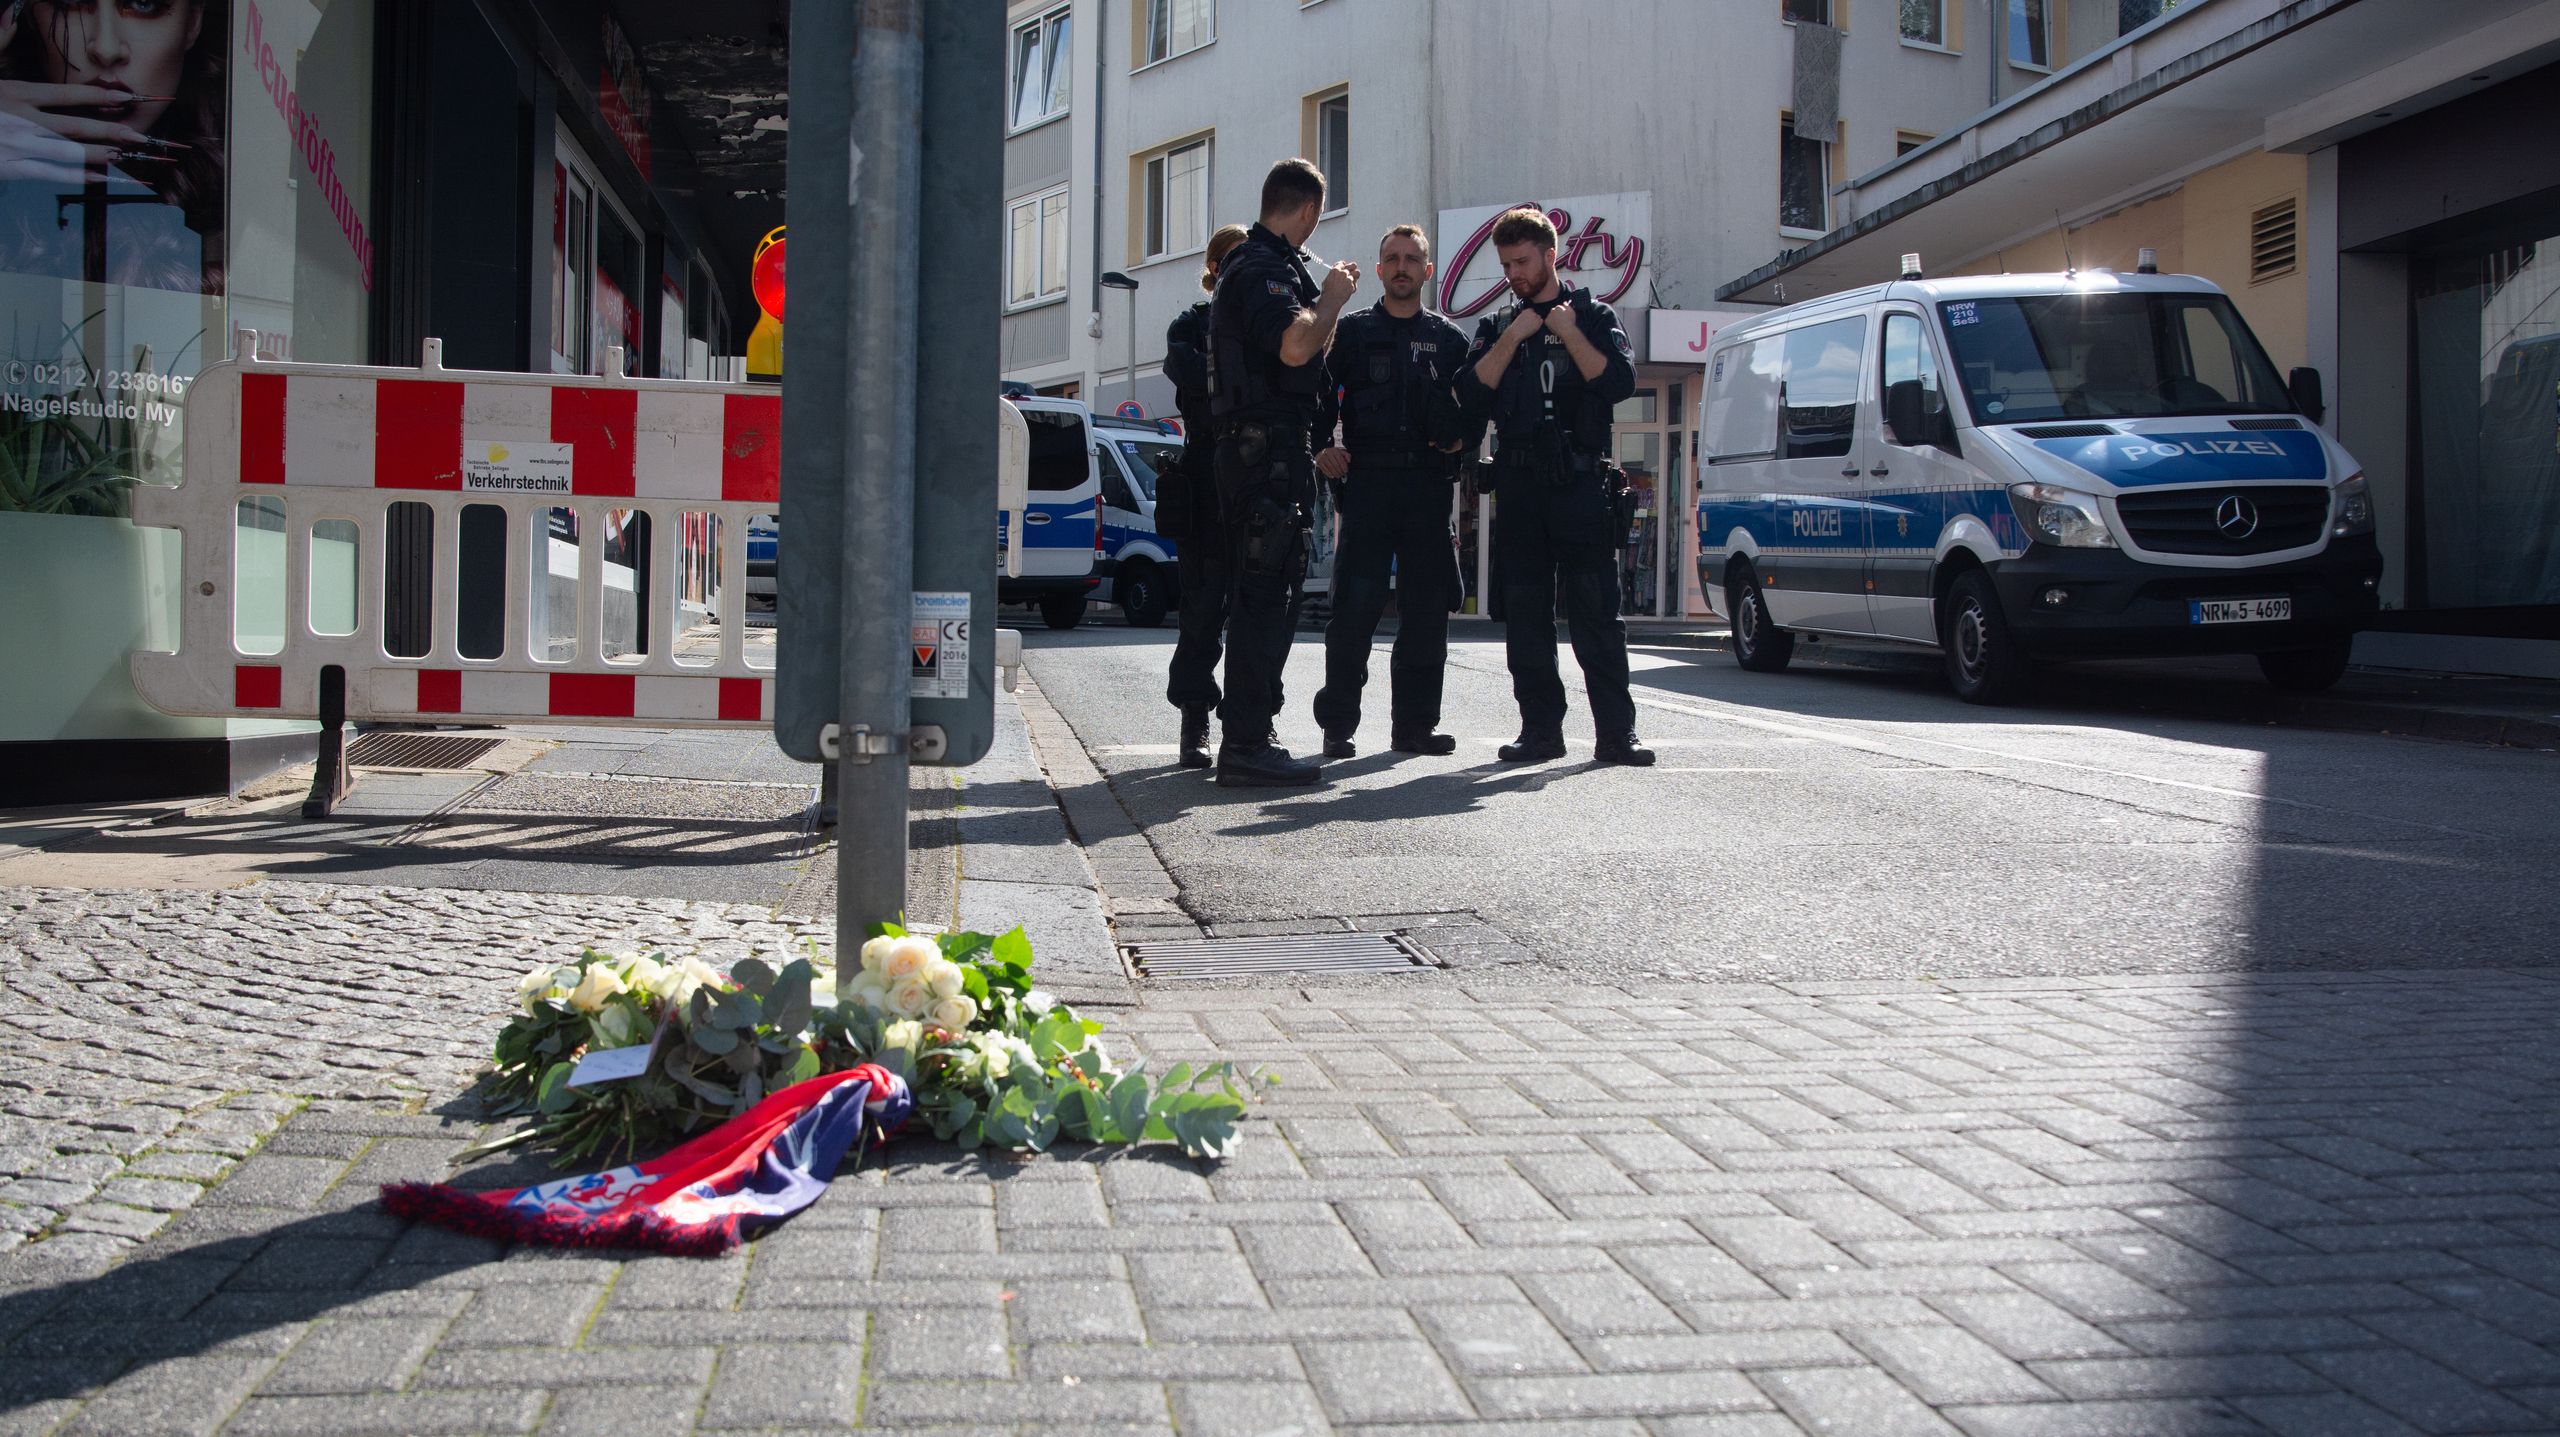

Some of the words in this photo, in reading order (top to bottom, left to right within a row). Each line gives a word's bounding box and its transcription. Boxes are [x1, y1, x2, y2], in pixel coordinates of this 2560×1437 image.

[244, 1, 374, 293] Neueröffnung
[1947, 302, 1976, 312] NRW
[1953, 310, 1974, 319] 210
[1410, 341, 1437, 353] POLIZEI
[1688, 321, 1717, 353] J
[33, 364, 87, 388] 0212
[93, 368, 101, 388] /
[3, 392, 138, 420] Nagelstudio
[145, 402, 176, 426] My
[2120, 440, 2287, 462] POLIZEI
[467, 472, 569, 491] Verkehrstechnik
[1792, 509, 1841, 537] POLIZEI
[2201, 603, 2230, 621] NRW
[2239, 600, 2290, 619] 5-4699
[942, 650, 967, 661] 2016
